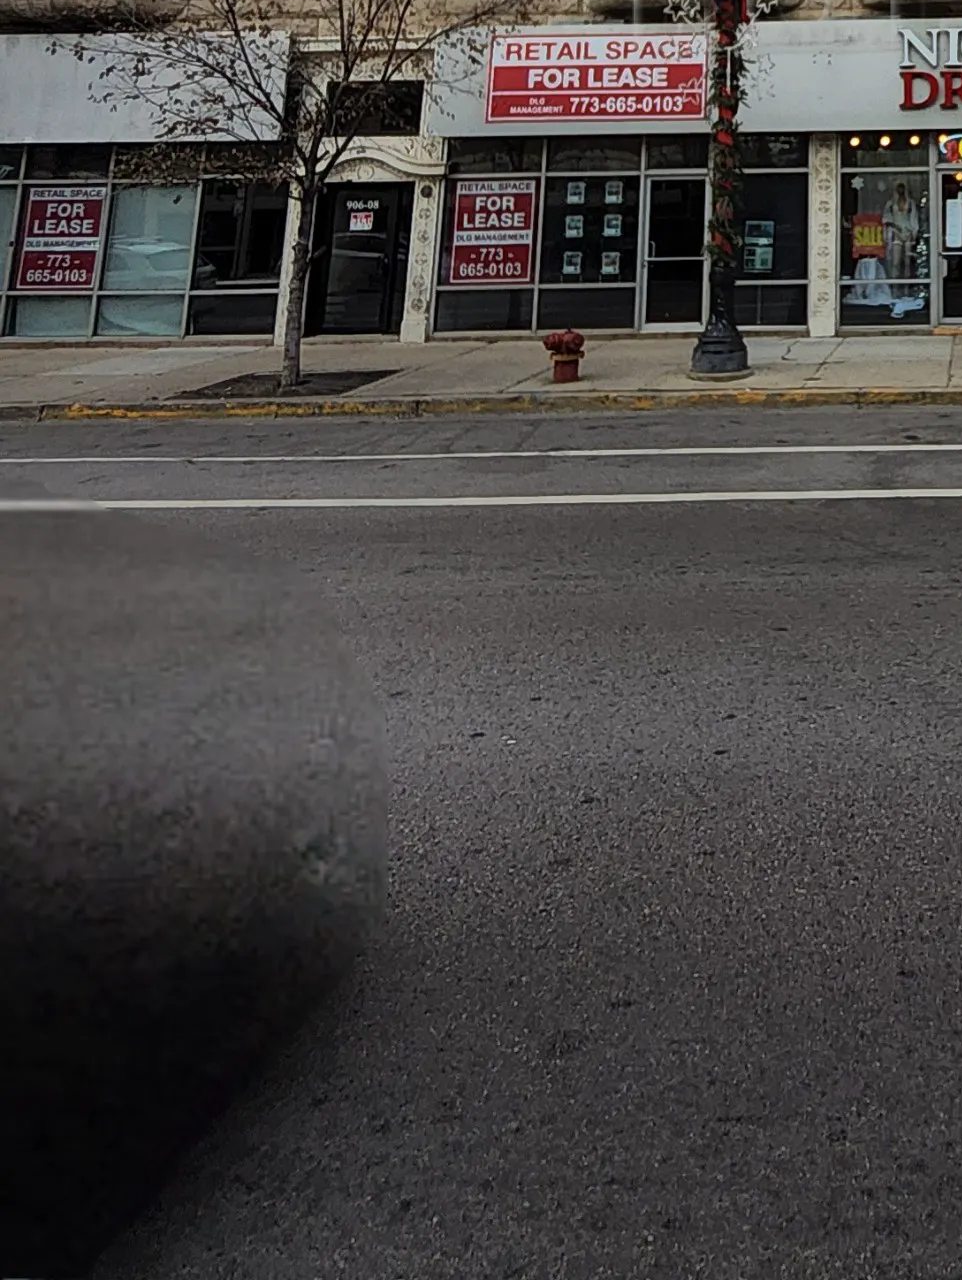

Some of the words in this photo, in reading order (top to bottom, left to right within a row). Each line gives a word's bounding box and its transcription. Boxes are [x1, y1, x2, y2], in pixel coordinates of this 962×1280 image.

[505, 41, 598, 61] RETAIL
[605, 40, 693, 60] SPACE
[527, 68, 580, 89] FOR
[587, 67, 669, 88] LEASE
[509, 104, 564, 114] MANAGEMENT
[569, 95, 684, 114] 773-665-0103
[33, 189, 68, 198] RETAIL
[70, 189, 104, 198] SPACE
[459, 183, 496, 192] RETAIL
[498, 182, 533, 191] SPACE
[346, 200, 379, 210] 906-08
[475, 196, 515, 211] FOR
[46, 203, 85, 218] FOR
[33, 219, 95, 234] LEASE
[463, 212, 526, 228] LEASE
[474, 233, 530, 241] MANAGEMENT
[43, 240, 99, 248] MANAGEMENT
[46, 254, 71, 267] 773
[479, 248, 504, 261] 773
[26, 269, 87, 282] 665-0103
[459, 262, 522, 276] 665-0103
